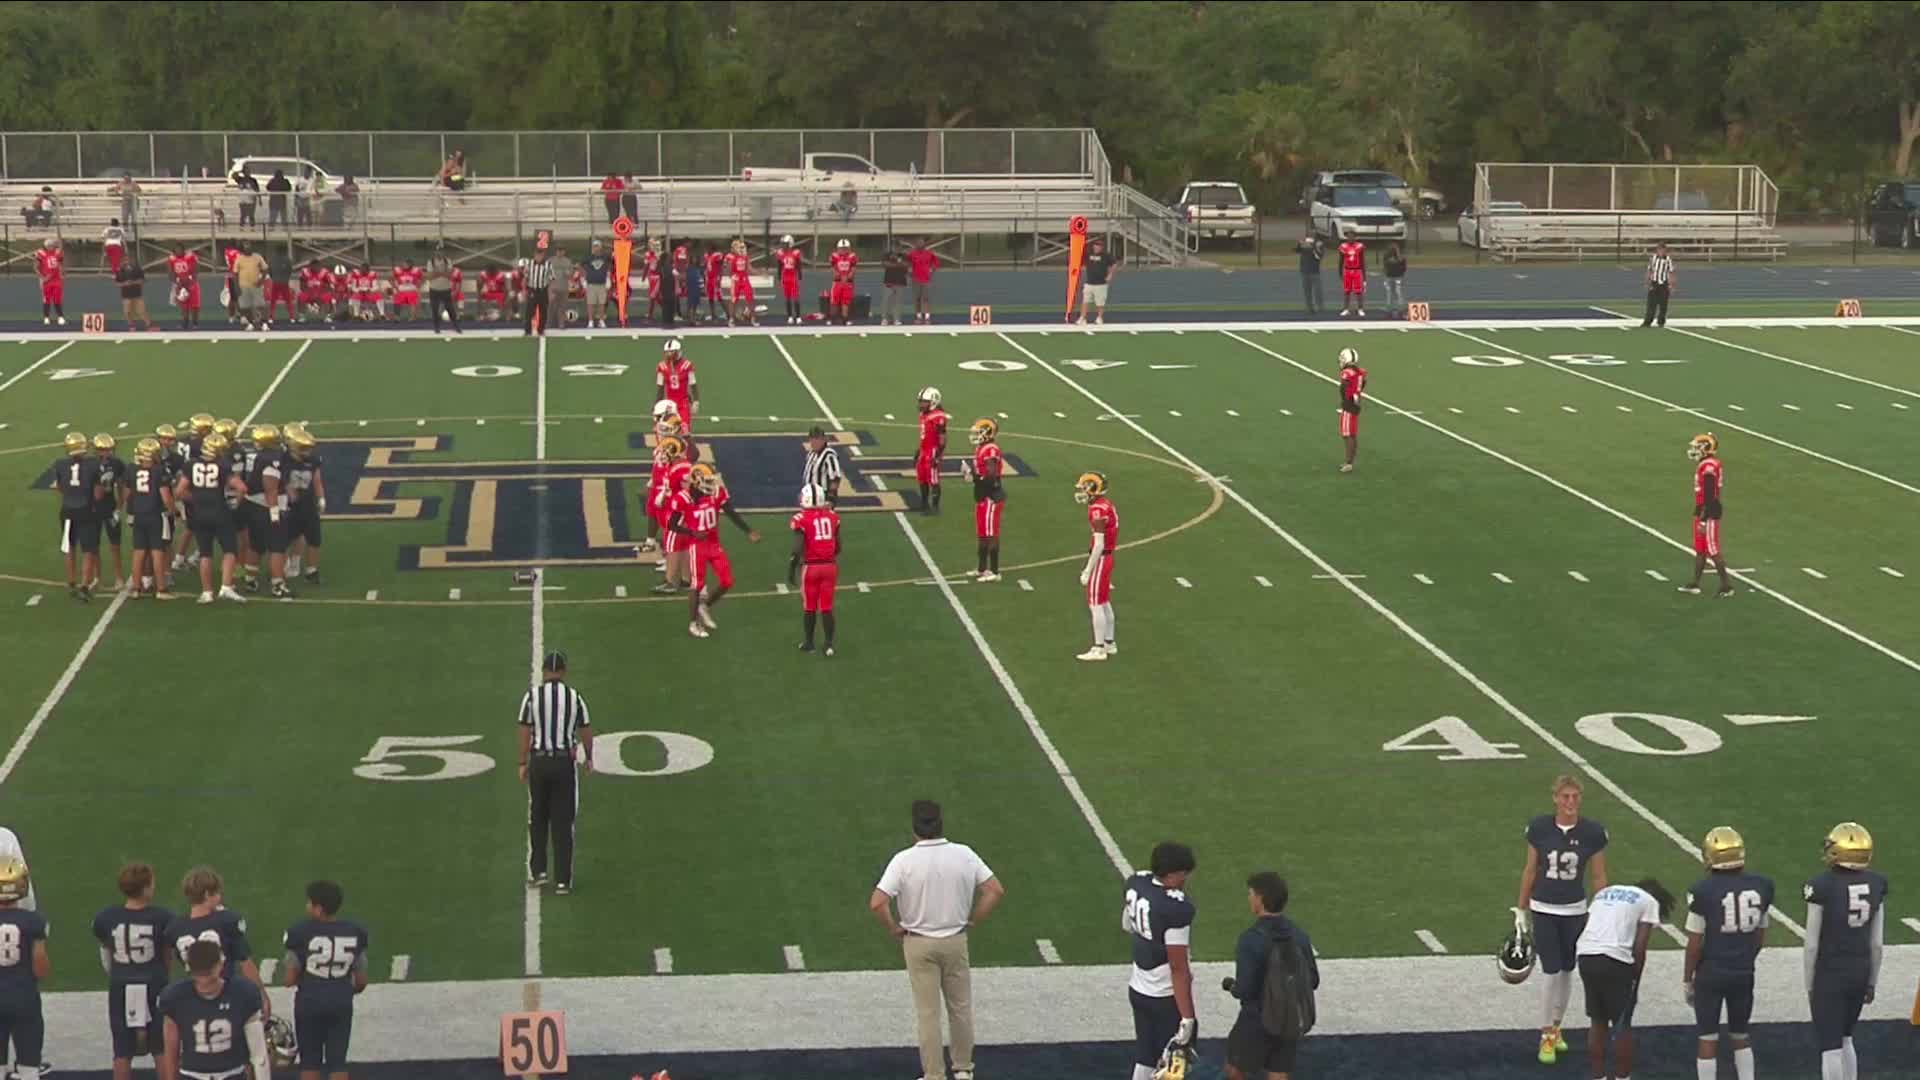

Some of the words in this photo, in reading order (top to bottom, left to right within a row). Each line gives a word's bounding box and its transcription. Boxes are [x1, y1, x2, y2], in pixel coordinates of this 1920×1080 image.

[85, 315, 104, 331] 40
[972, 308, 989, 324] 40
[1411, 304, 1428, 321] 30
[1844, 302, 1859, 318] 20
[69, 463, 81, 487] 1
[135, 469, 150, 493] 2
[192, 461, 219, 489] 62
[693, 507, 717, 532] 70
[813, 517, 833, 541] 10
[1545, 849, 1579, 881] 13
[1720, 889, 1762, 933] 16
[1847, 883, 1871, 929] 5
[111, 922, 155, 964] 15
[305, 935, 358, 979] 25
[191, 1018, 232, 1054] 12
[510, 1016, 560, 1072] 50
